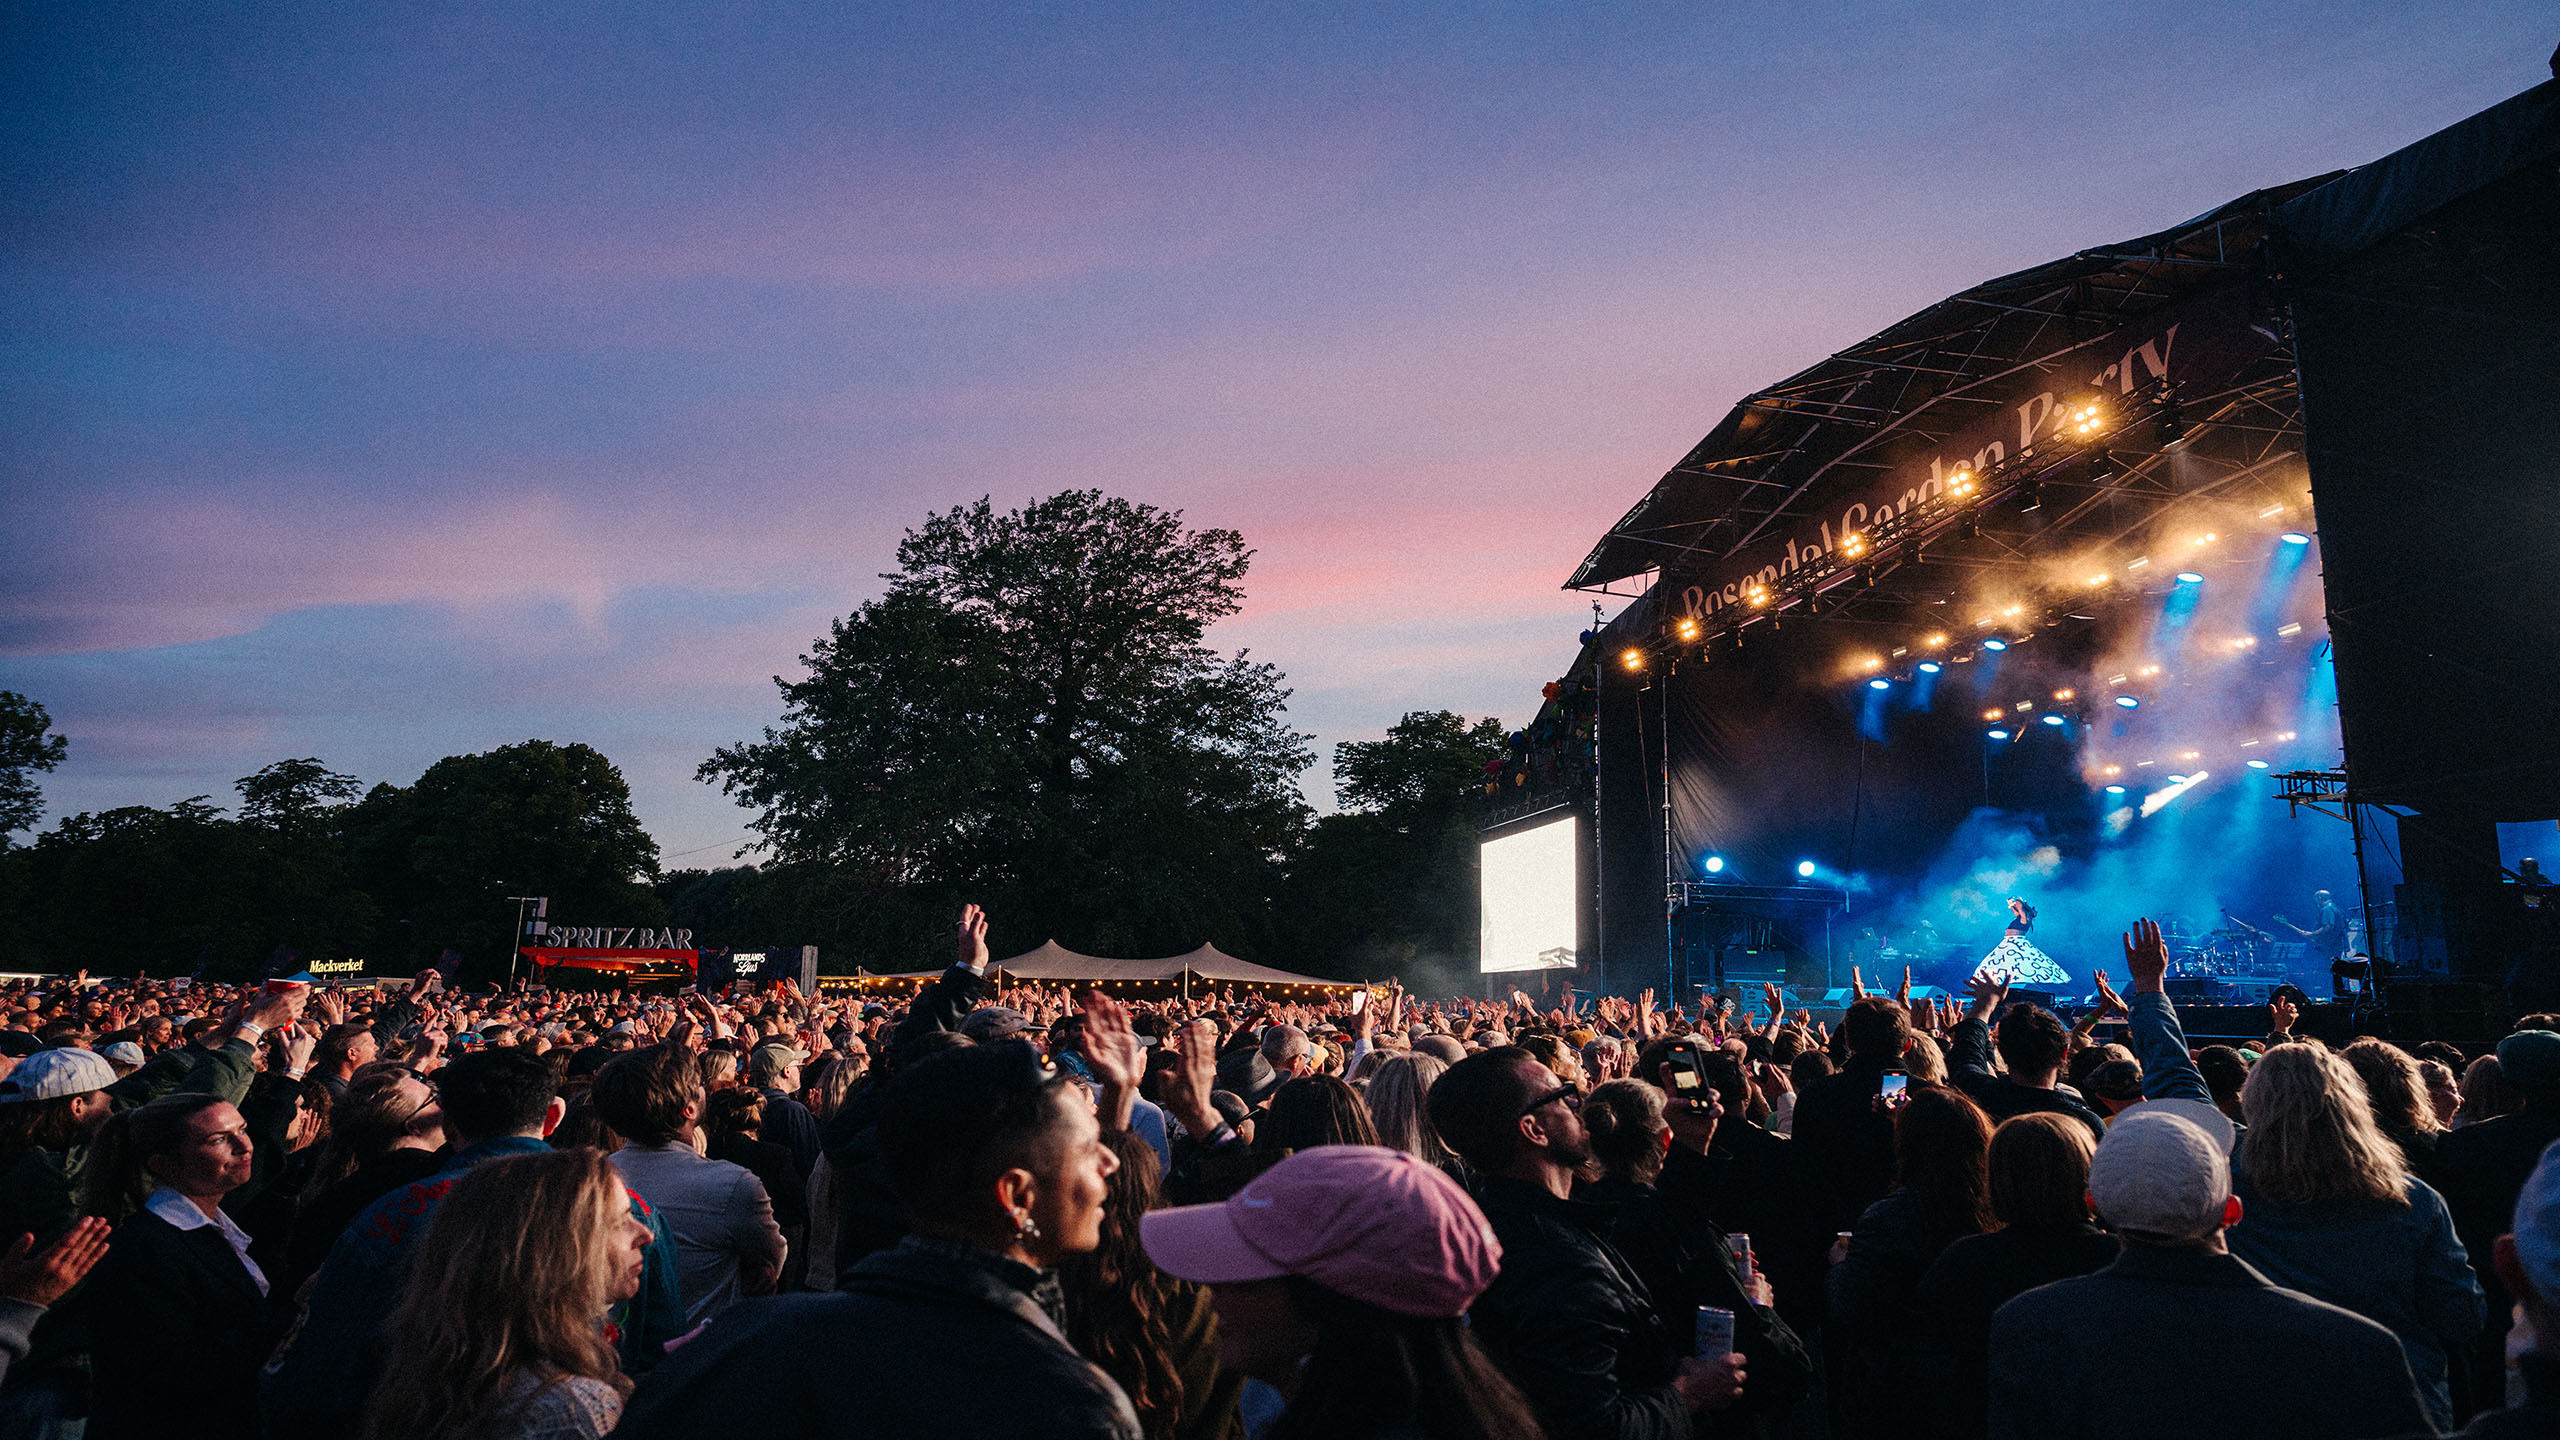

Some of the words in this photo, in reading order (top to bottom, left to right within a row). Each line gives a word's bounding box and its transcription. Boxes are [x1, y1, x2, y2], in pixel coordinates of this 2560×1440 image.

[2016, 321, 2181, 457] Prty
[545, 926, 634, 949] SPRITZ
[638, 926, 693, 950] BAR
[308, 958, 364, 973] Mackverket
